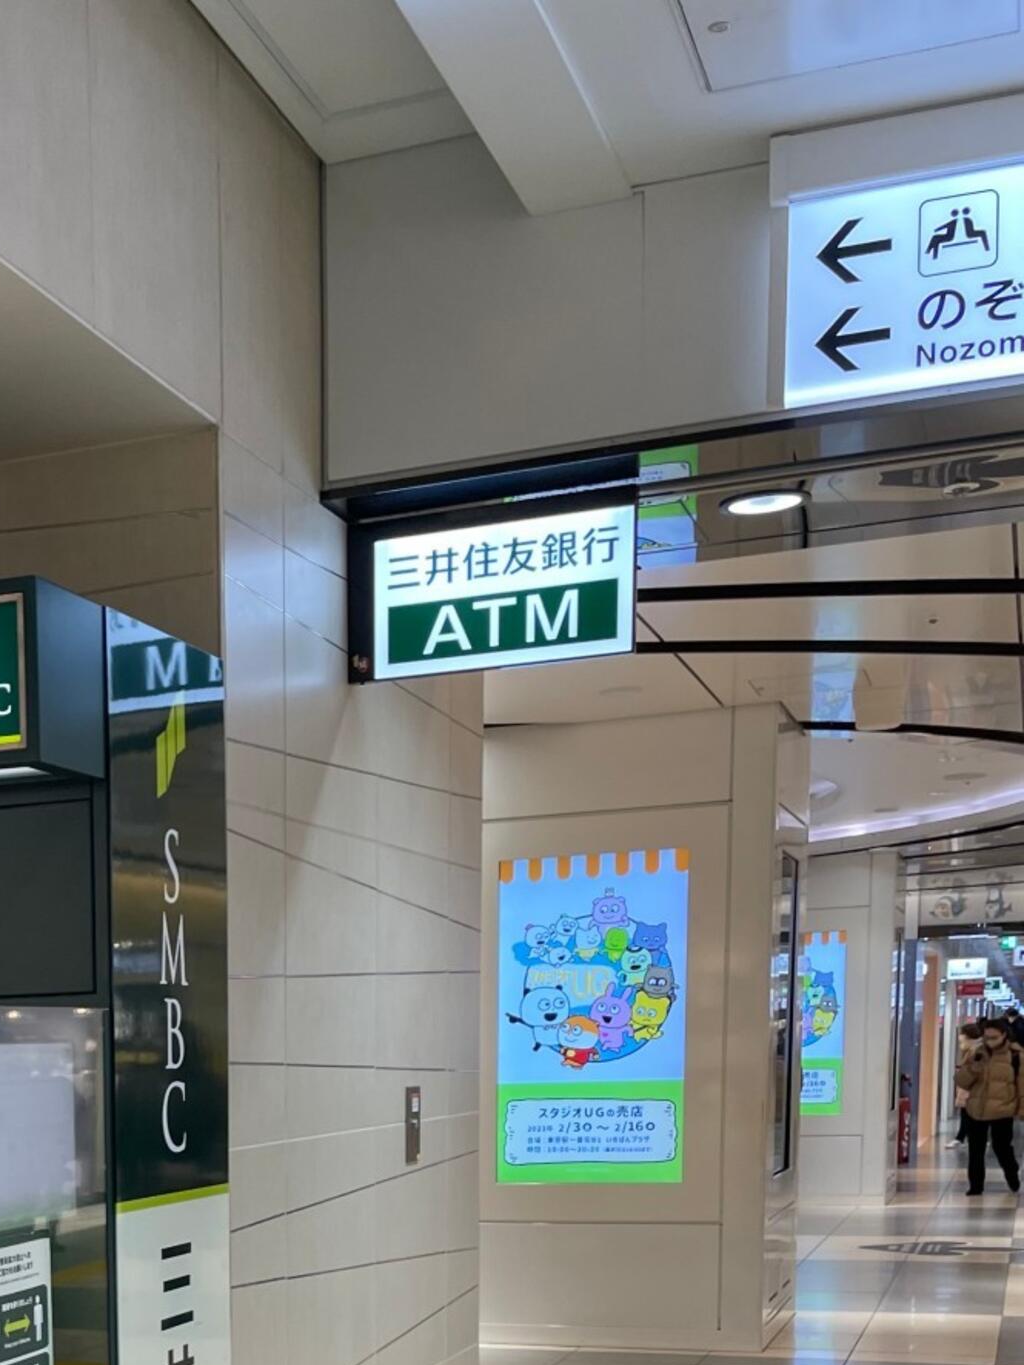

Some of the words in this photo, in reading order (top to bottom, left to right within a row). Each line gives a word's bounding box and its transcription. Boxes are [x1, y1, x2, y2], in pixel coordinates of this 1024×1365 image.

[917, 279, 1024, 330] のぞ
[387, 526, 619, 590] 三井住友銀行
[423, 588, 578, 655] ATM
[160, 828, 189, 1154] SMBC
[538, 1104, 644, 1119] スタジオUGの売店
